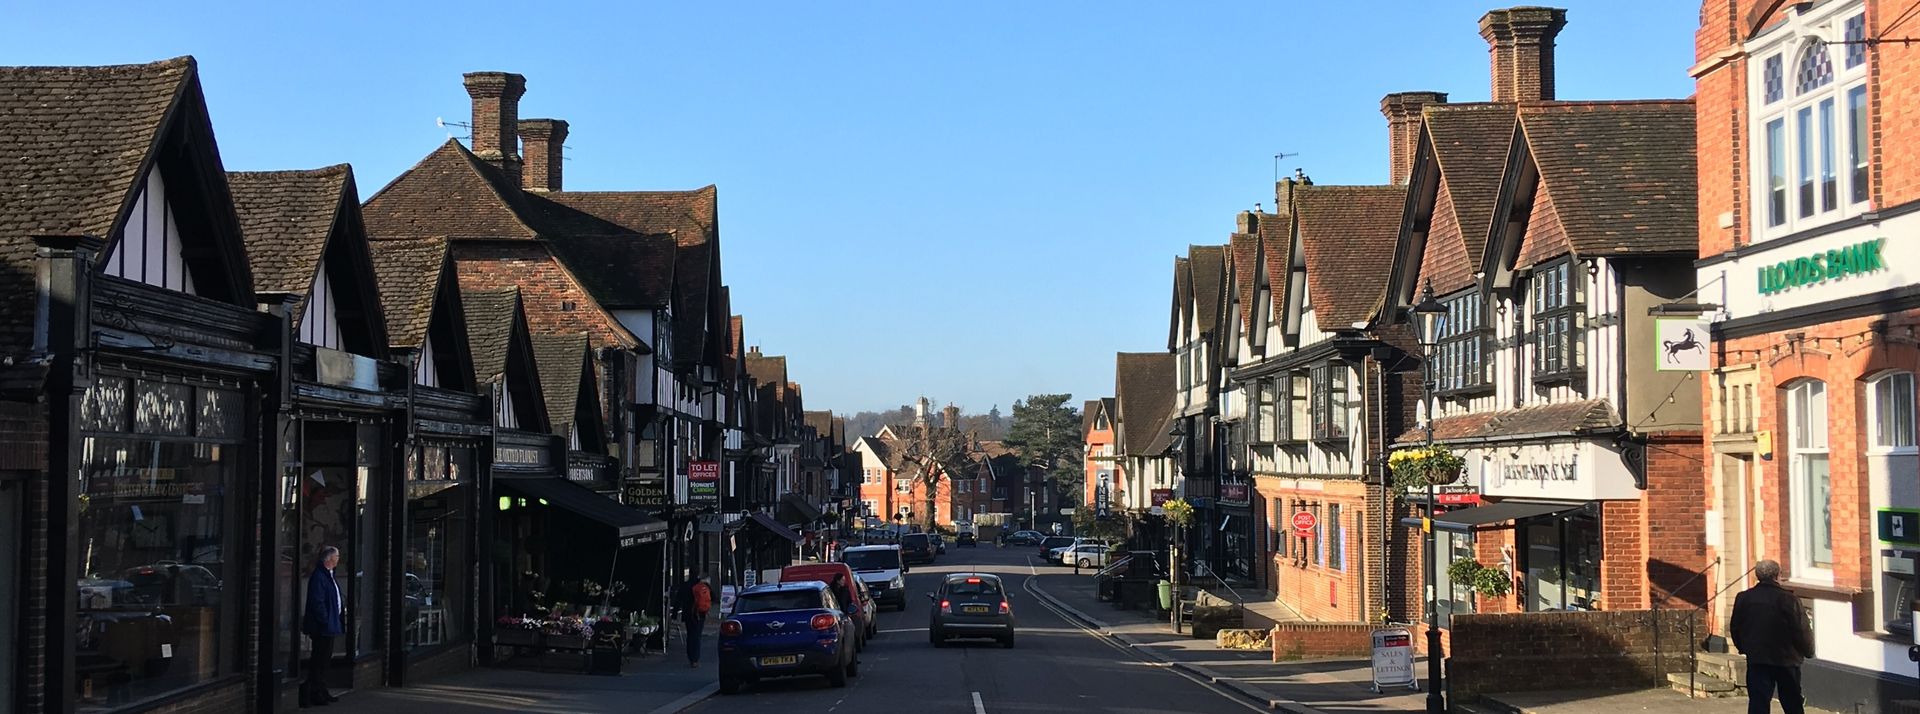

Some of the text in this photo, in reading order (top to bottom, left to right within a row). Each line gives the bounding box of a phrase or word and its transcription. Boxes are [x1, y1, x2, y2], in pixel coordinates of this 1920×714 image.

[1758, 239, 1887, 294] LLOYDS BANK
[628, 487, 663, 496] GOLDEN
[1098, 472, 1106, 517] CINEMA
[628, 497, 663, 505] PALACE
[1377, 665, 1410, 673] LETTINGS
